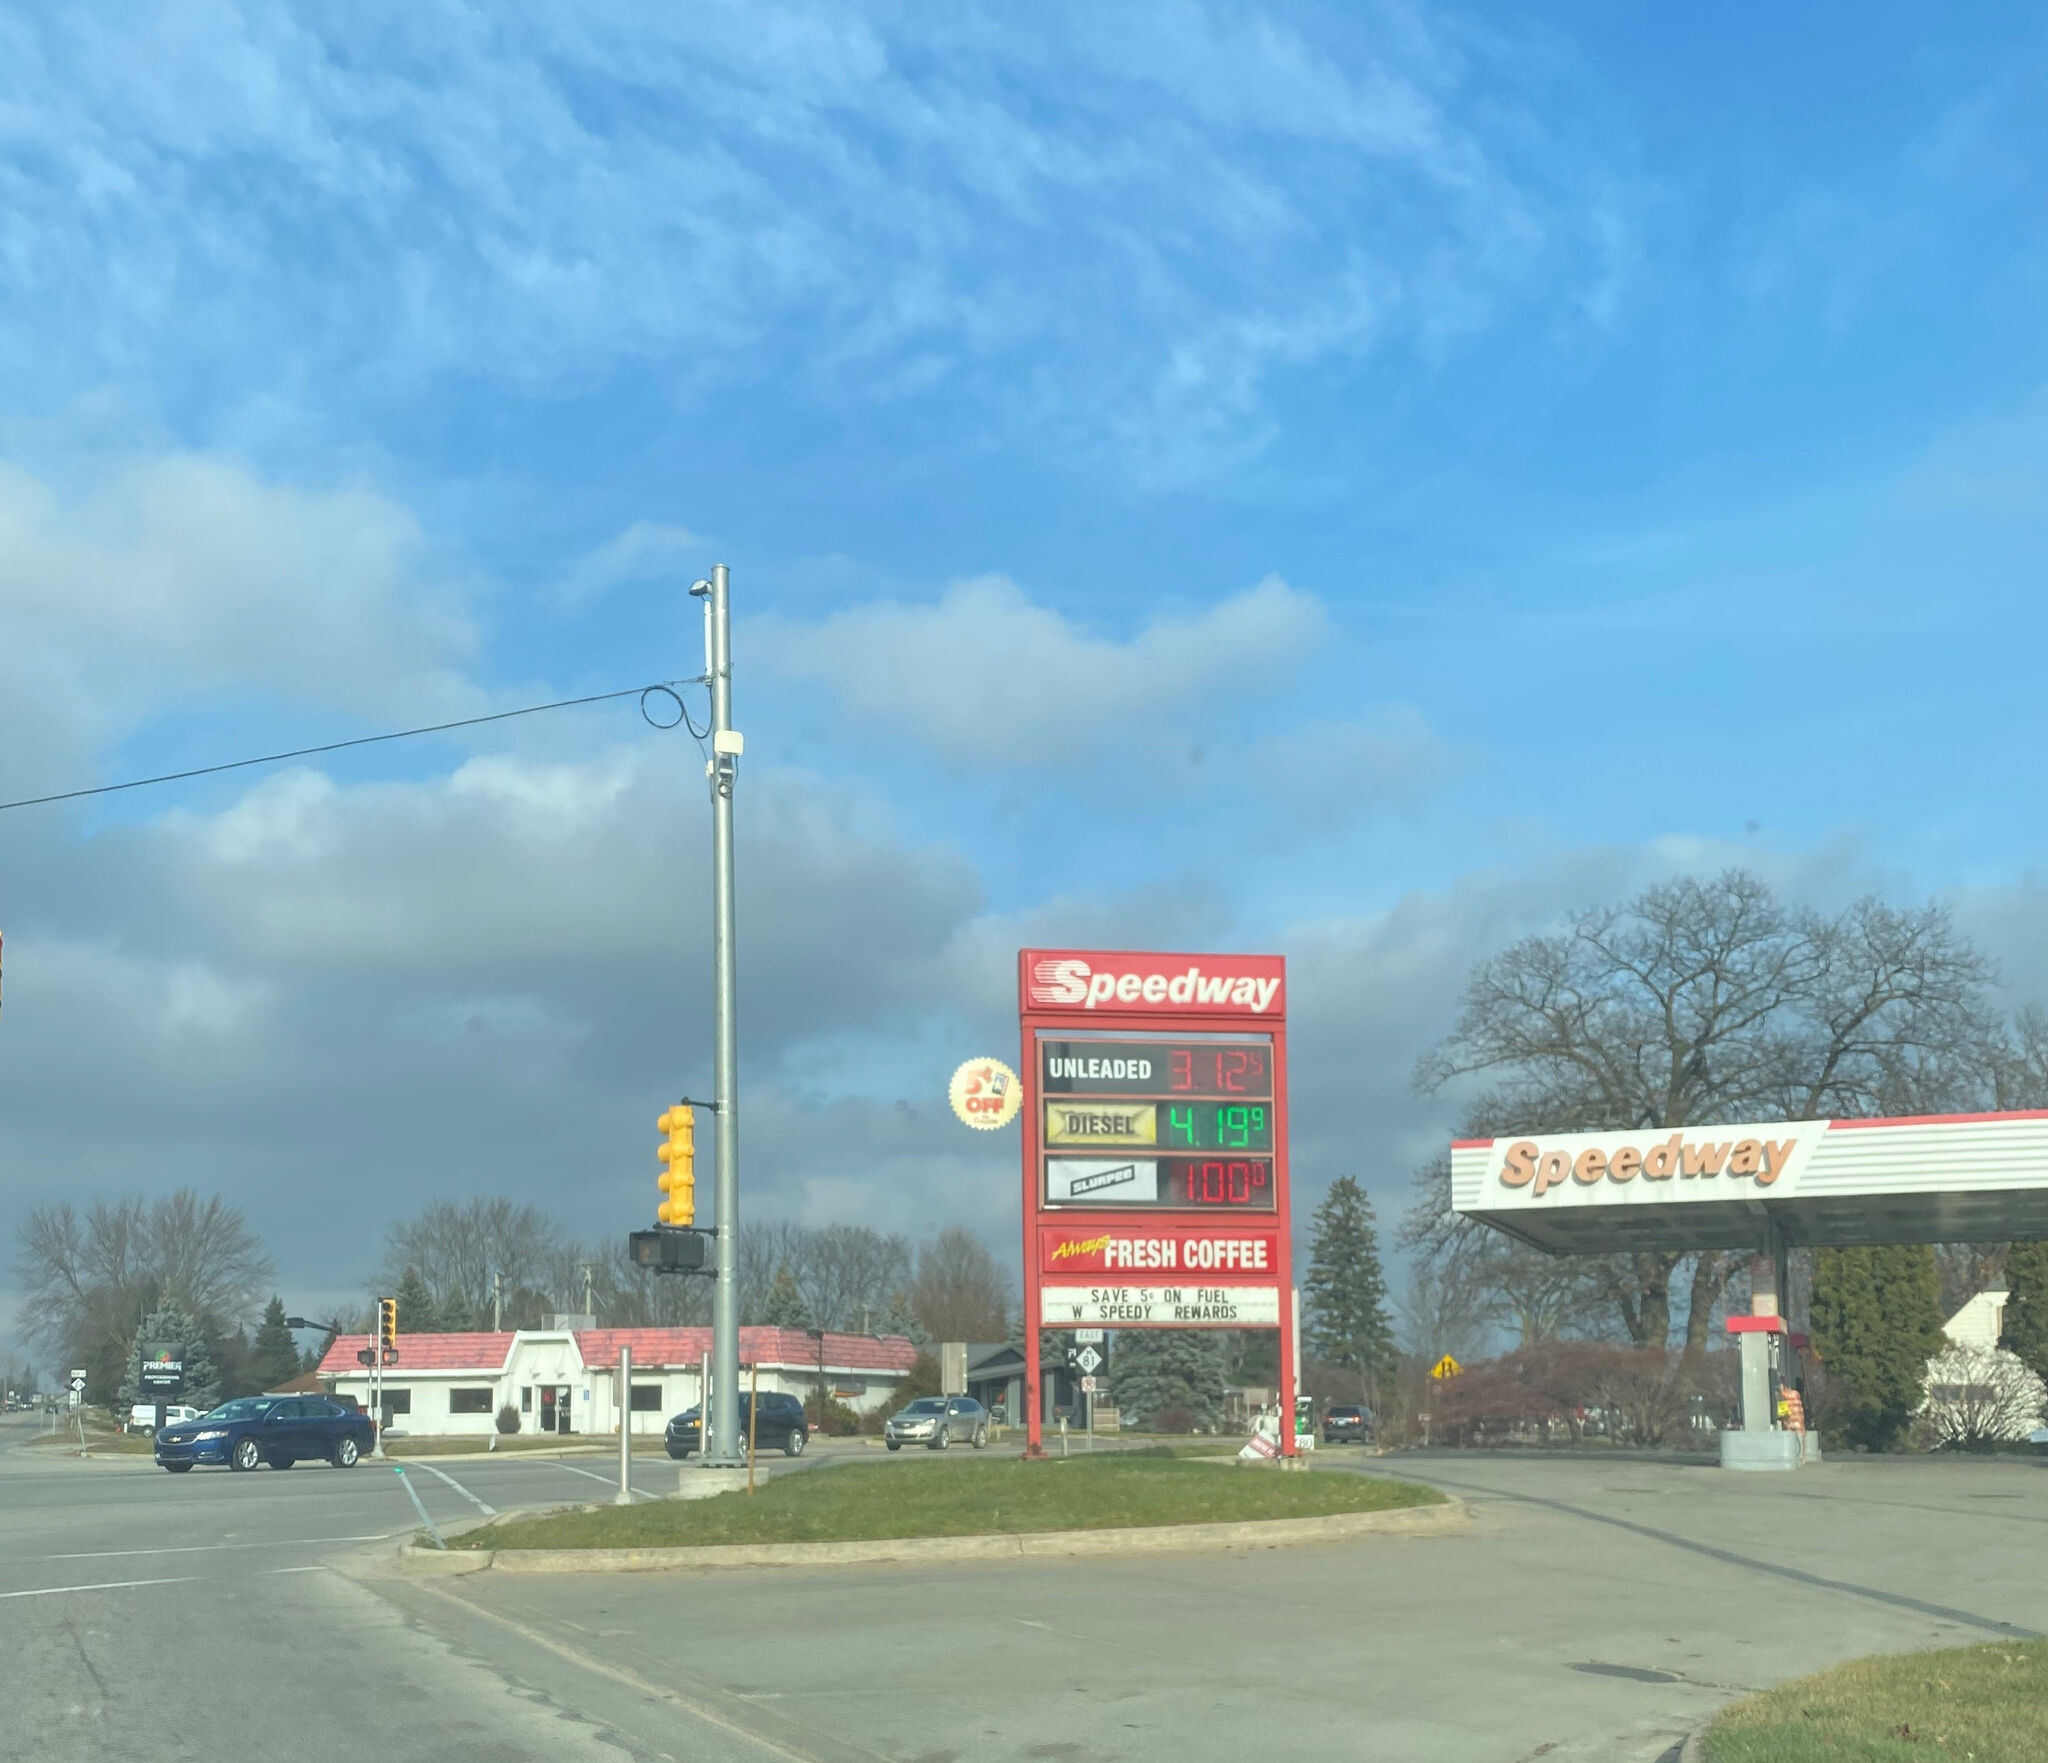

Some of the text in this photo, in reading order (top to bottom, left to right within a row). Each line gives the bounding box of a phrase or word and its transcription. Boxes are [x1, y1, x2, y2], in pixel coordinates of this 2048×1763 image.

[1030, 959, 1281, 1013] Speedway
[1049, 1057, 1152, 1080] UNLEADED
[966, 1097, 1005, 1114] OFF
[1068, 1113, 1136, 1135] DIESEL
[1500, 1133, 1798, 1197] Speedway
[1073, 1167, 1134, 1194] SLURPEE
[1104, 1239, 1177, 1268] FRESH
[1183, 1239, 1268, 1269] COFFEE
[1091, 1289, 1129, 1303] SAVE
[1164, 1289, 1182, 1303] ON
[1197, 1289, 1229, 1304] FUEL
[1072, 1304, 1238, 1320] W SPEEDY REWARDS
[1080, 1329, 1100, 1340] EAST
[143, 1361, 182, 1371] PREMIER
[1082, 1355, 1095, 1367] 81
